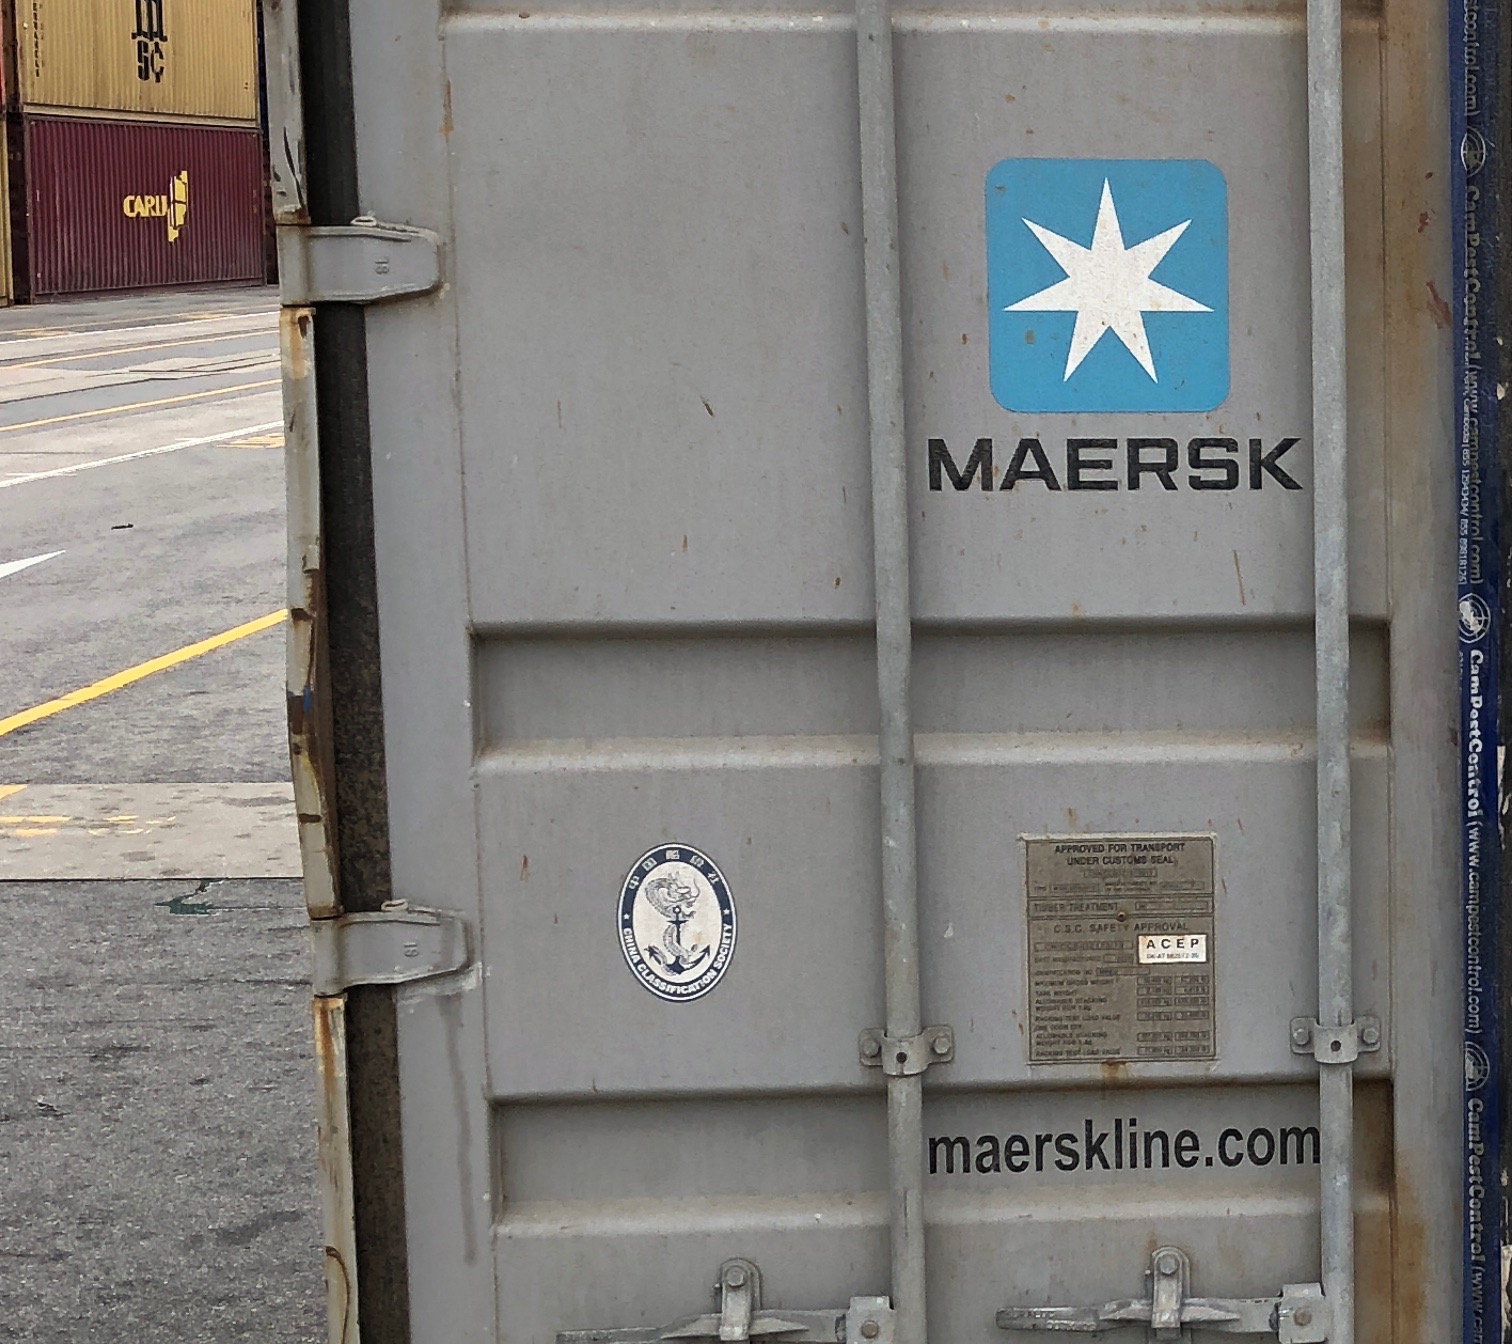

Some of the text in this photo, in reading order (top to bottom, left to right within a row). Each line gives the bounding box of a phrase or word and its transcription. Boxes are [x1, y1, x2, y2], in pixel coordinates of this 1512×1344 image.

[927, 437, 1304, 492] MAERSK
[1466, 650, 1484, 818] CamPestControl
[1055, 842, 1186, 853] APPROVED FOR TRANSPORT
[1067, 855, 1175, 865] UNDER CUSTOMS SEAL
[1089, 924, 1129, 932] SAFETY
[1134, 922, 1189, 931] APPROVAL
[624, 923, 733, 995] CHINA CLASSIFICATION SOCIETY
[928, 1117, 1321, 1175] maerskline.com
[1467, 1098, 1485, 1262] CamPestControl
